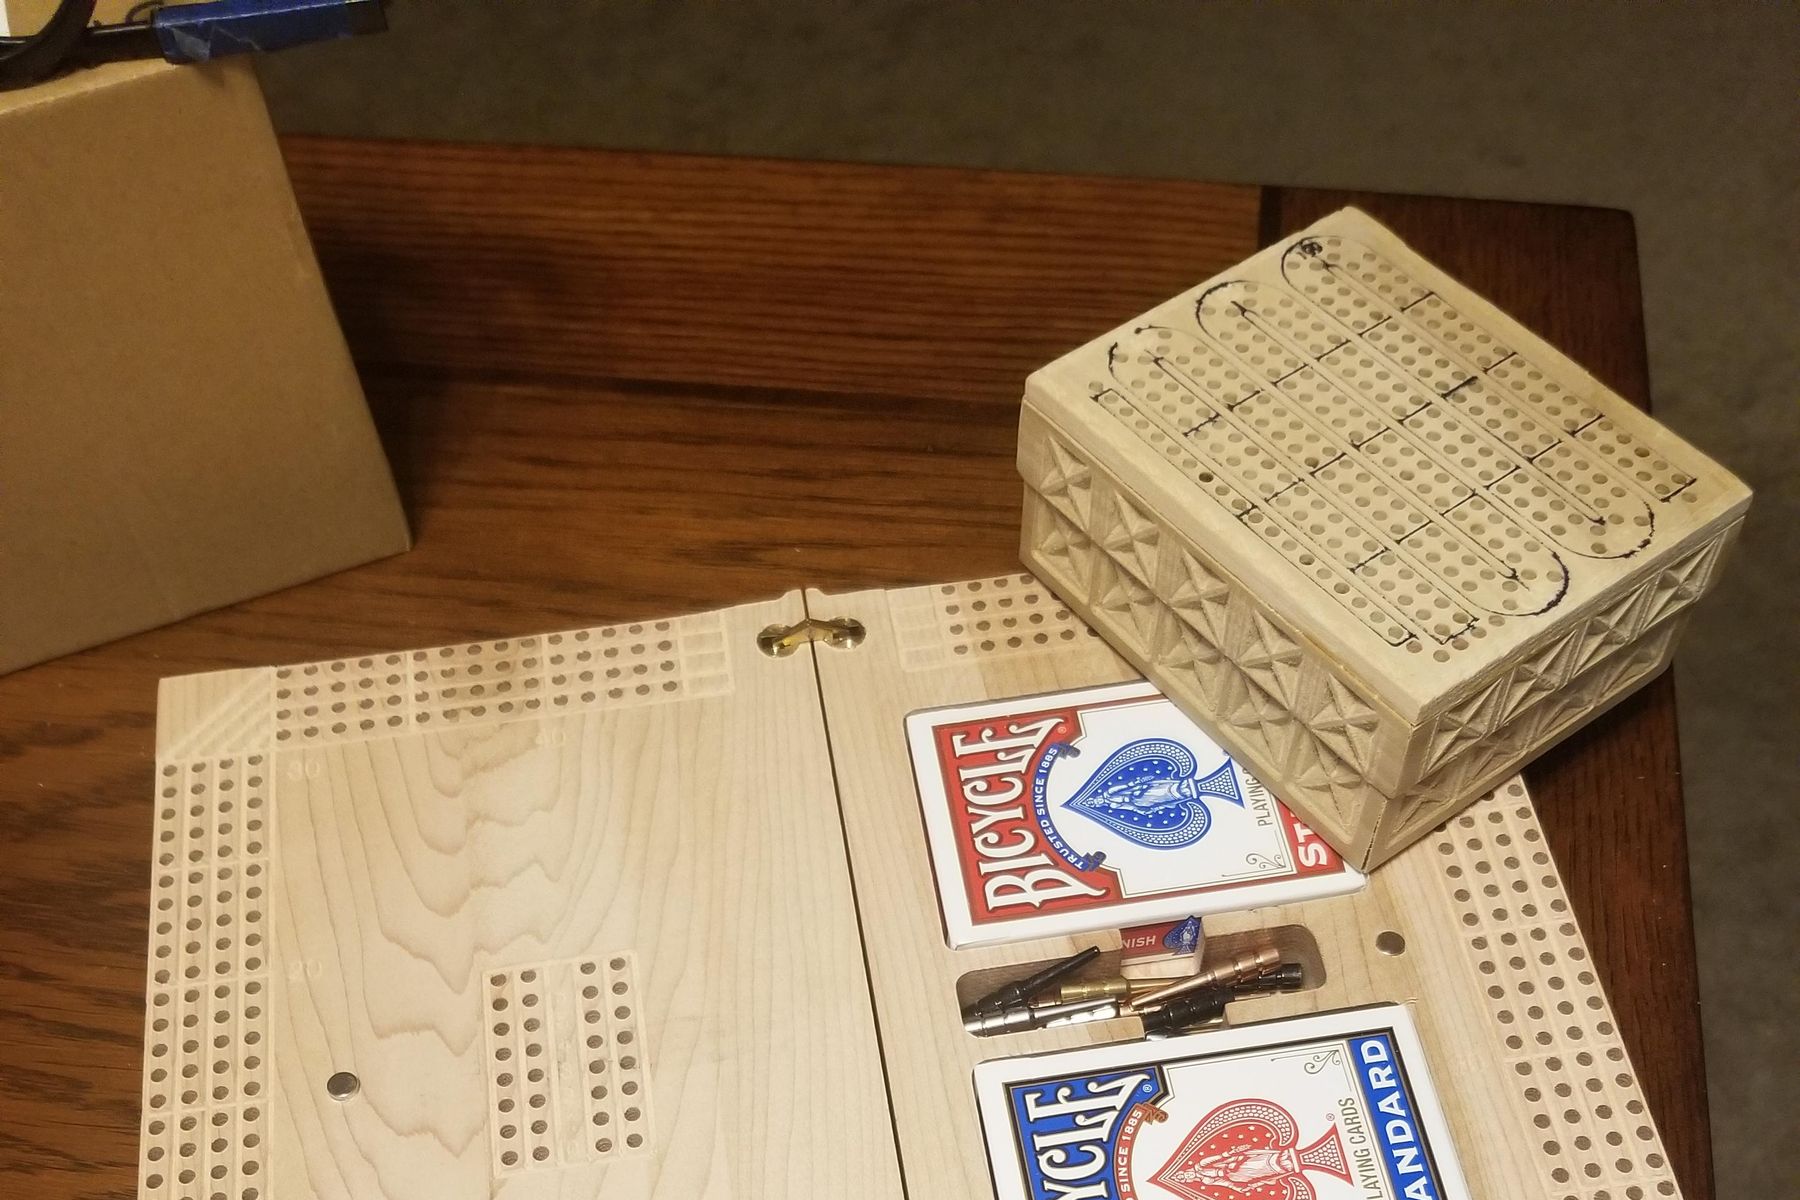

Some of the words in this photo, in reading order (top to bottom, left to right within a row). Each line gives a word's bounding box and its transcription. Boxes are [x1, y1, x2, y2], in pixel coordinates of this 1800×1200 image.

[1039, 747, 1058, 774] 1885
[952, 717, 1105, 910] BICYCLE
[1034, 777, 1046, 816] SINCE
[1245, 778, 1273, 828] PLAYING
[1040, 820, 1084, 870] TRUSTED
[1291, 813, 1328, 868] ST
[1121, 1109, 1143, 1142] 1885
[1339, 1097, 1367, 1146] CARDS
[1118, 1147, 1131, 1192] SINCE
